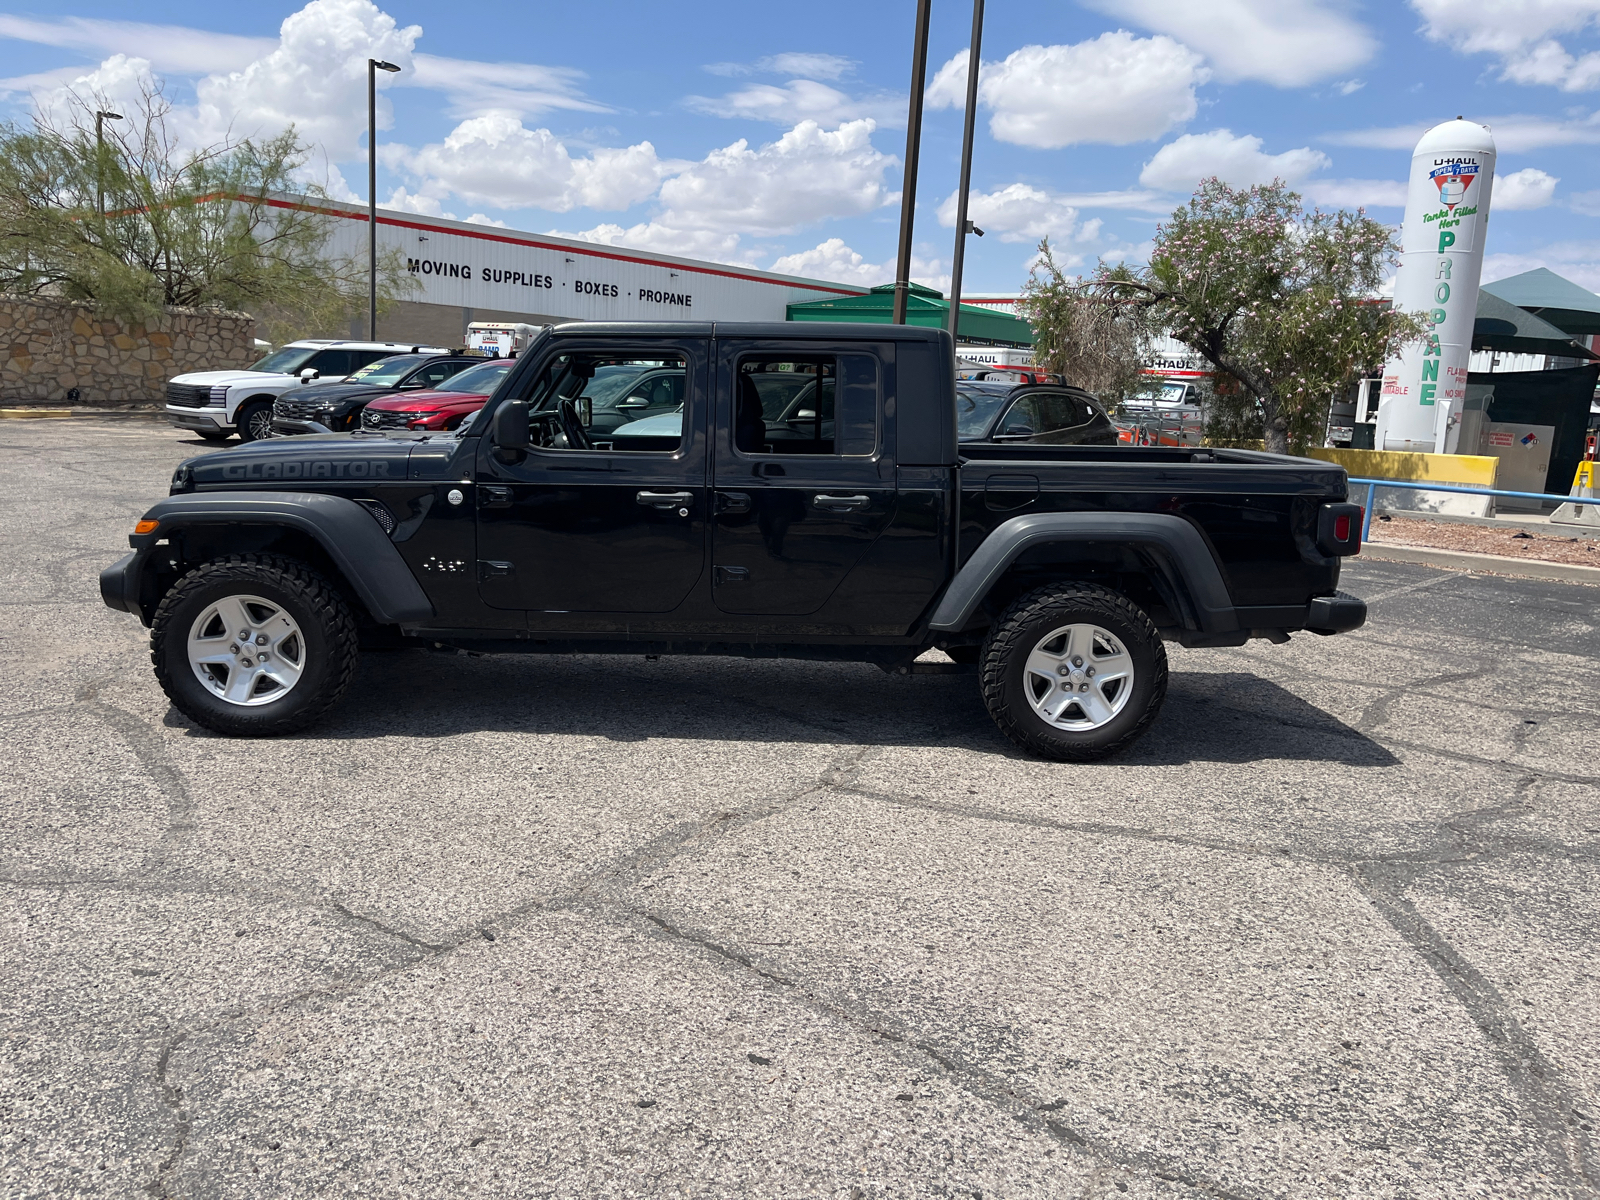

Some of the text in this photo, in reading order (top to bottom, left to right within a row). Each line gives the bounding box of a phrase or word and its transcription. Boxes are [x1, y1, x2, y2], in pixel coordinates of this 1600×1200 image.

[1434, 157, 1477, 166] U-HAUL
[1434, 165, 1452, 176] OPEN
[1423, 204, 1478, 223] Tanks Filled
[1438, 218, 1460, 230] Here
[407, 258, 692, 307] MOVING SUPPLIES BOXES PROPANE
[1420, 231, 1456, 406] PROPANE
[222, 461, 390, 478] GLADIATOR
